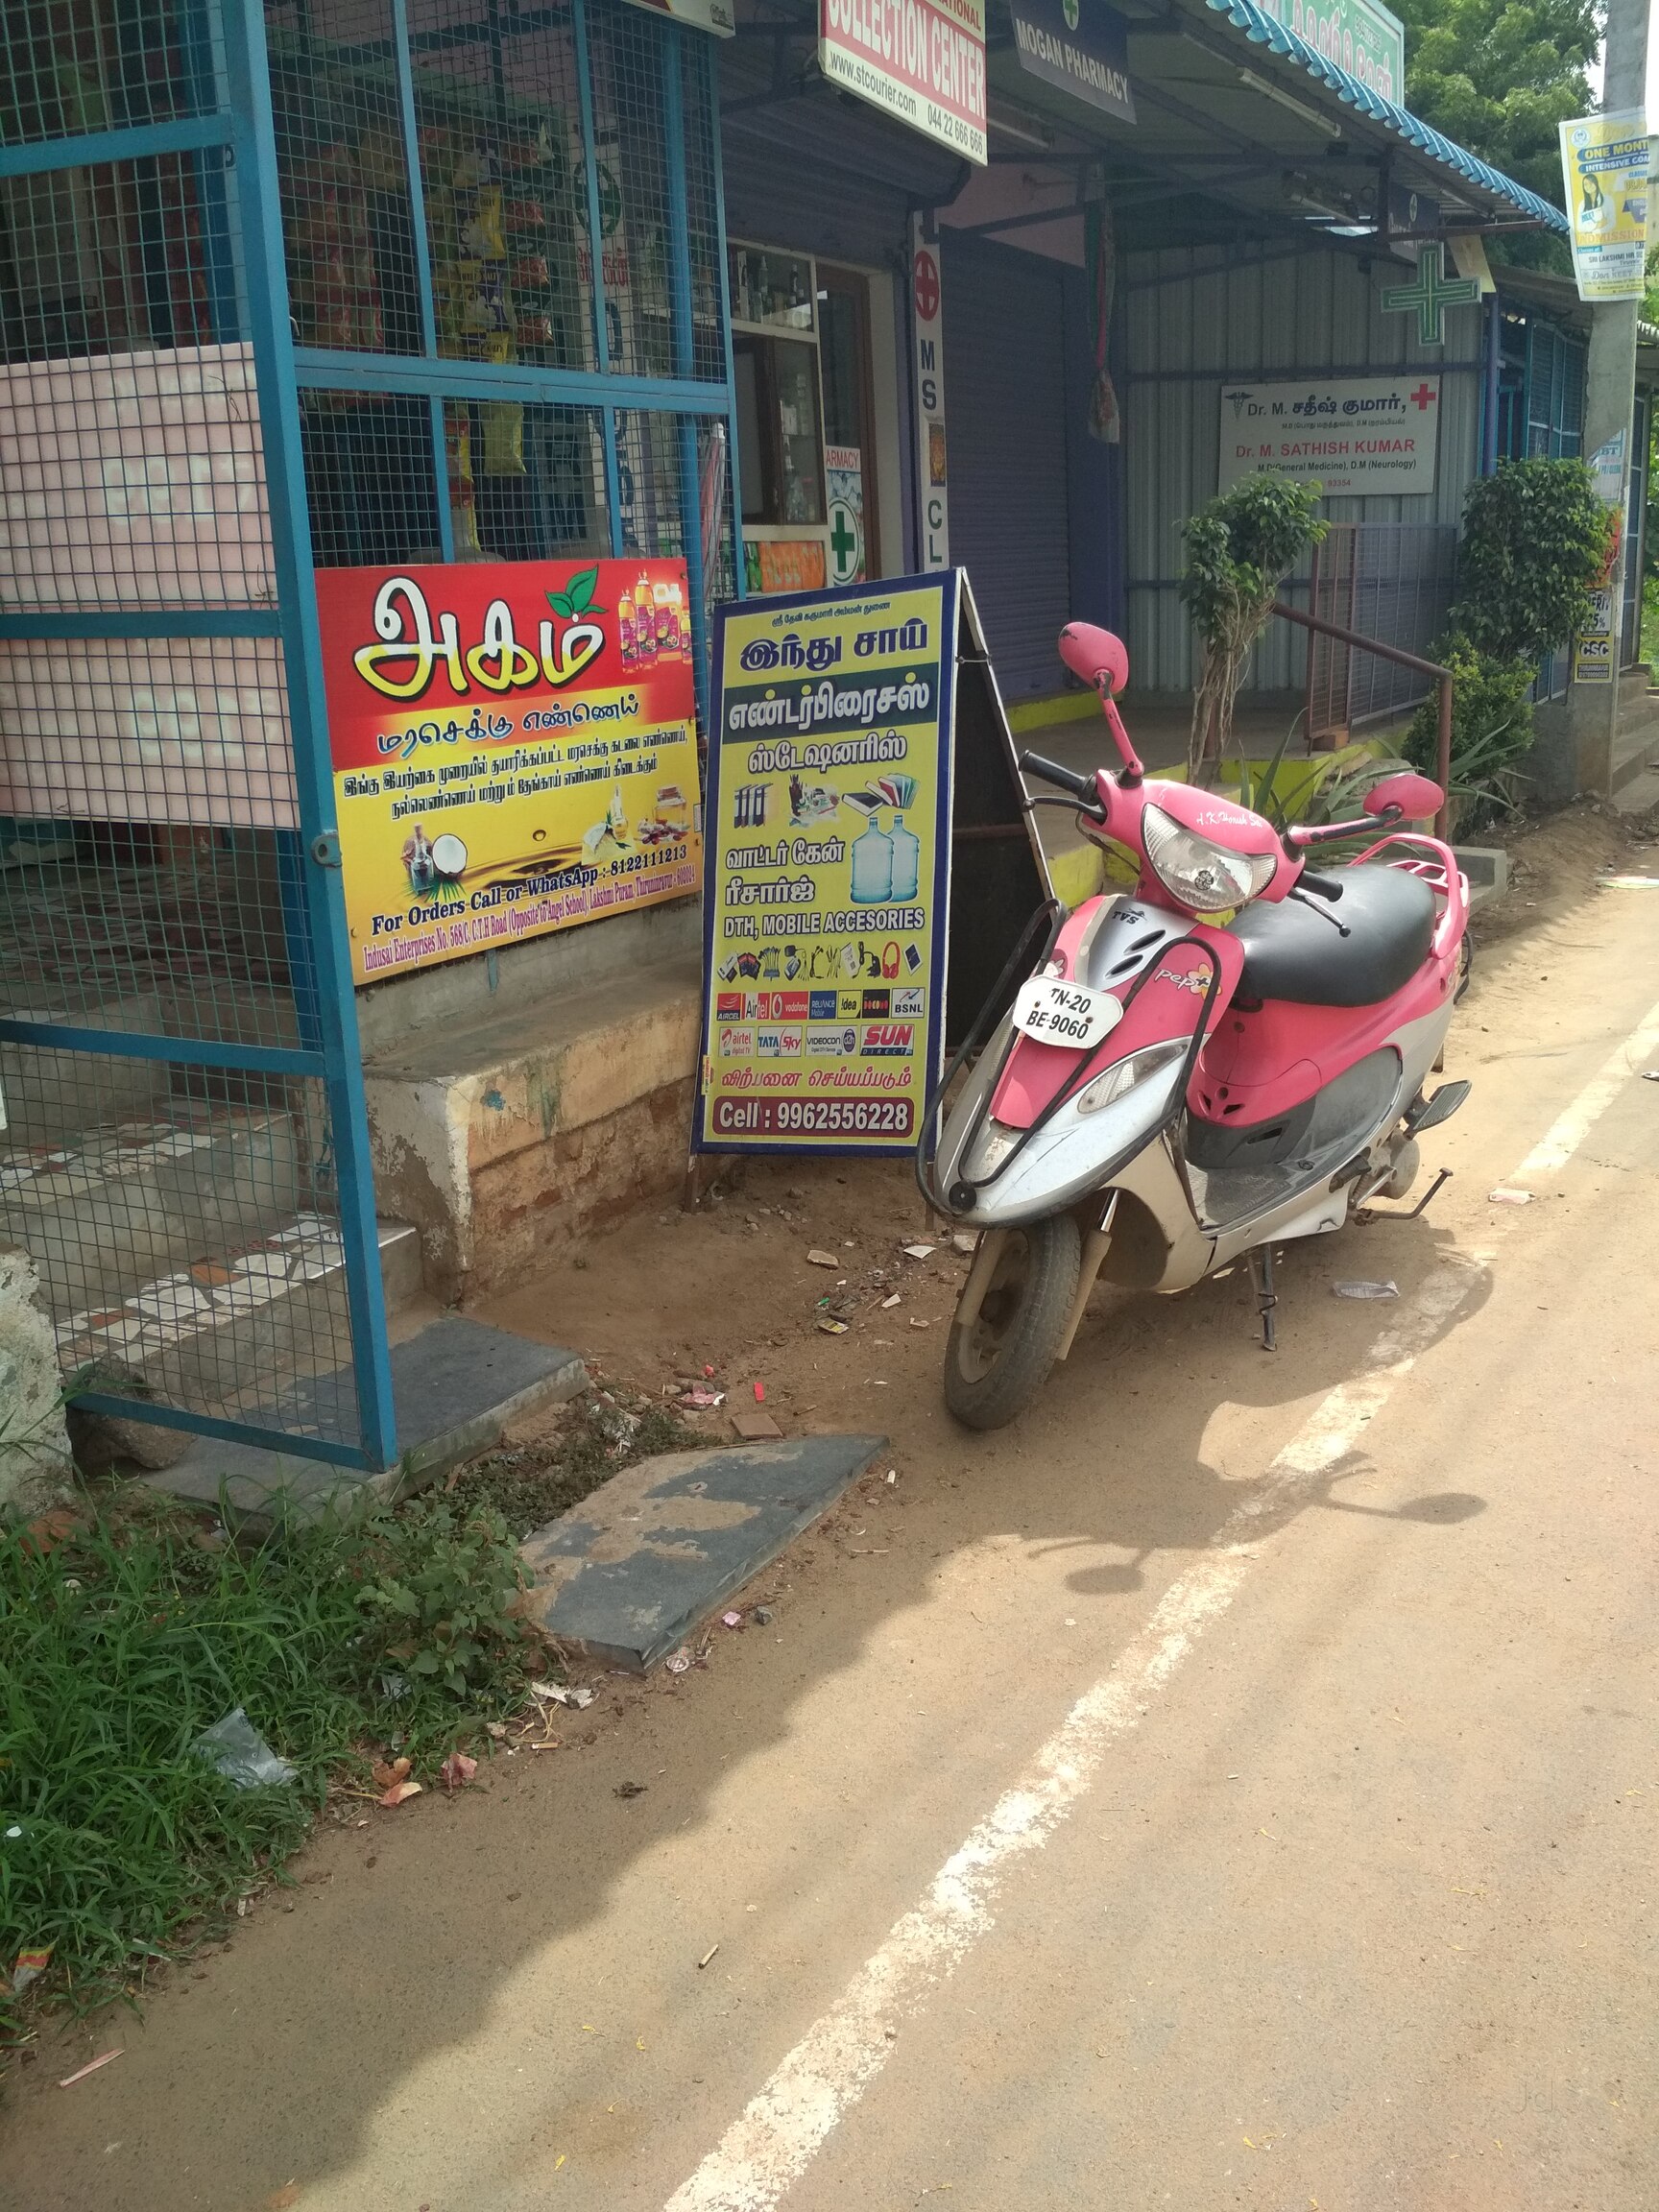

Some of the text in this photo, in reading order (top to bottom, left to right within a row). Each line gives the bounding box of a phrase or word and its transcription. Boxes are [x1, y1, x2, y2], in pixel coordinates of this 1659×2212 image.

[931, 15, 985, 120] CENTER
[1016, 18, 1128, 104] MOGAN PHARMACY
[830, 51, 983, 156] www.stcourier.com 044 22 666 666
[1585, 146, 1611, 160] ONE
[1585, 158, 1630, 172] INTENSIVE
[1599, 253, 1624, 263] LAKSHMI
[1248, 403, 1266, 417] Dr.
[1271, 402, 1287, 416] M.
[1292, 394, 1337, 417] சதீஷ்
[1236, 439, 1415, 458] Dr. M. SATHISH KUMAR
[1308, 461, 1348, 471] Medicine),
[1350, 460, 1367, 469] D.M
[1368, 458, 1417, 471] (Neurology)
[784, 612, 803, 625] தேவி
[833, 604, 862, 617] அம்மன்
[863, 601, 891, 615] துணை
[353, 576, 606, 698] அகம்
[740, 617, 927, 672] இந்து சாய்
[1580, 641, 1609, 659] CSC
[729, 672, 930, 731] எண்டர்பிரைசஸ்
[377, 693, 640, 758] மரசெக்கு எண்ணெய்
[748, 729, 907, 773] ஸ்டேஷனரிஸ்
[344, 774, 379, 797] இங்கு
[383, 766, 435, 790] இயற்கை
[439, 755, 488, 785] முறையில்
[492, 743, 565, 776] தயாரிக்கப்பட்ட
[567, 737, 609, 763] மரசெக்கு
[611, 736, 640, 754] கடலை
[392, 753, 658, 820] நல்லெண்ணெய் மற்றும் தேங்காய் எண்ணெய் கிடைக்கும்
[726, 835, 845, 870] வாட்டர் கேன்
[373, 914, 403, 936] For
[408, 900, 466, 926] Orders
[470, 887, 502, 910] Call
[506, 887, 522, 902] or
[527, 868, 598, 897] WhatsApp
[611, 845, 686, 877] 8122111213
[725, 874, 815, 905] ரீசார்ஜ்
[363, 940, 394, 971] Indusai
[394, 928, 436, 965] Enterprises
[436, 926, 449, 951] No.
[471, 917, 490, 942] C.T.H
[491, 911, 508, 937] Road
[509, 902, 539, 937] (Opposite
[547, 895, 565, 926] Angel
[589, 883, 614, 909] Lakshmi
[614, 881, 636, 903] Puram,
[724, 907, 925, 940] DTH, MOBILE ACCESORIES
[1111, 909, 1140, 926] TVS
[746, 998, 768, 1019] Airtel
[784, 1001, 807, 1013] vodafone
[811, 999, 835, 1009] RELIANCE
[895, 1003, 924, 1014] BSNL
[1049, 987, 1092, 1014] TN-20
[717, 1012, 740, 1021] AIRCEL
[1025, 1010, 1090, 1040] BE-9060
[733, 1030, 752, 1045] airtel
[757, 1036, 802, 1051] TATA Sky
[806, 1037, 841, 1046] VIDEOCON
[863, 1024, 913, 1046] SUN
[722, 1066, 803, 1090] விற்பனை
[808, 1066, 912, 1090] செய்யப்படும்
[719, 1101, 757, 1128] Cell
[777, 1102, 908, 1131] 9962556228
